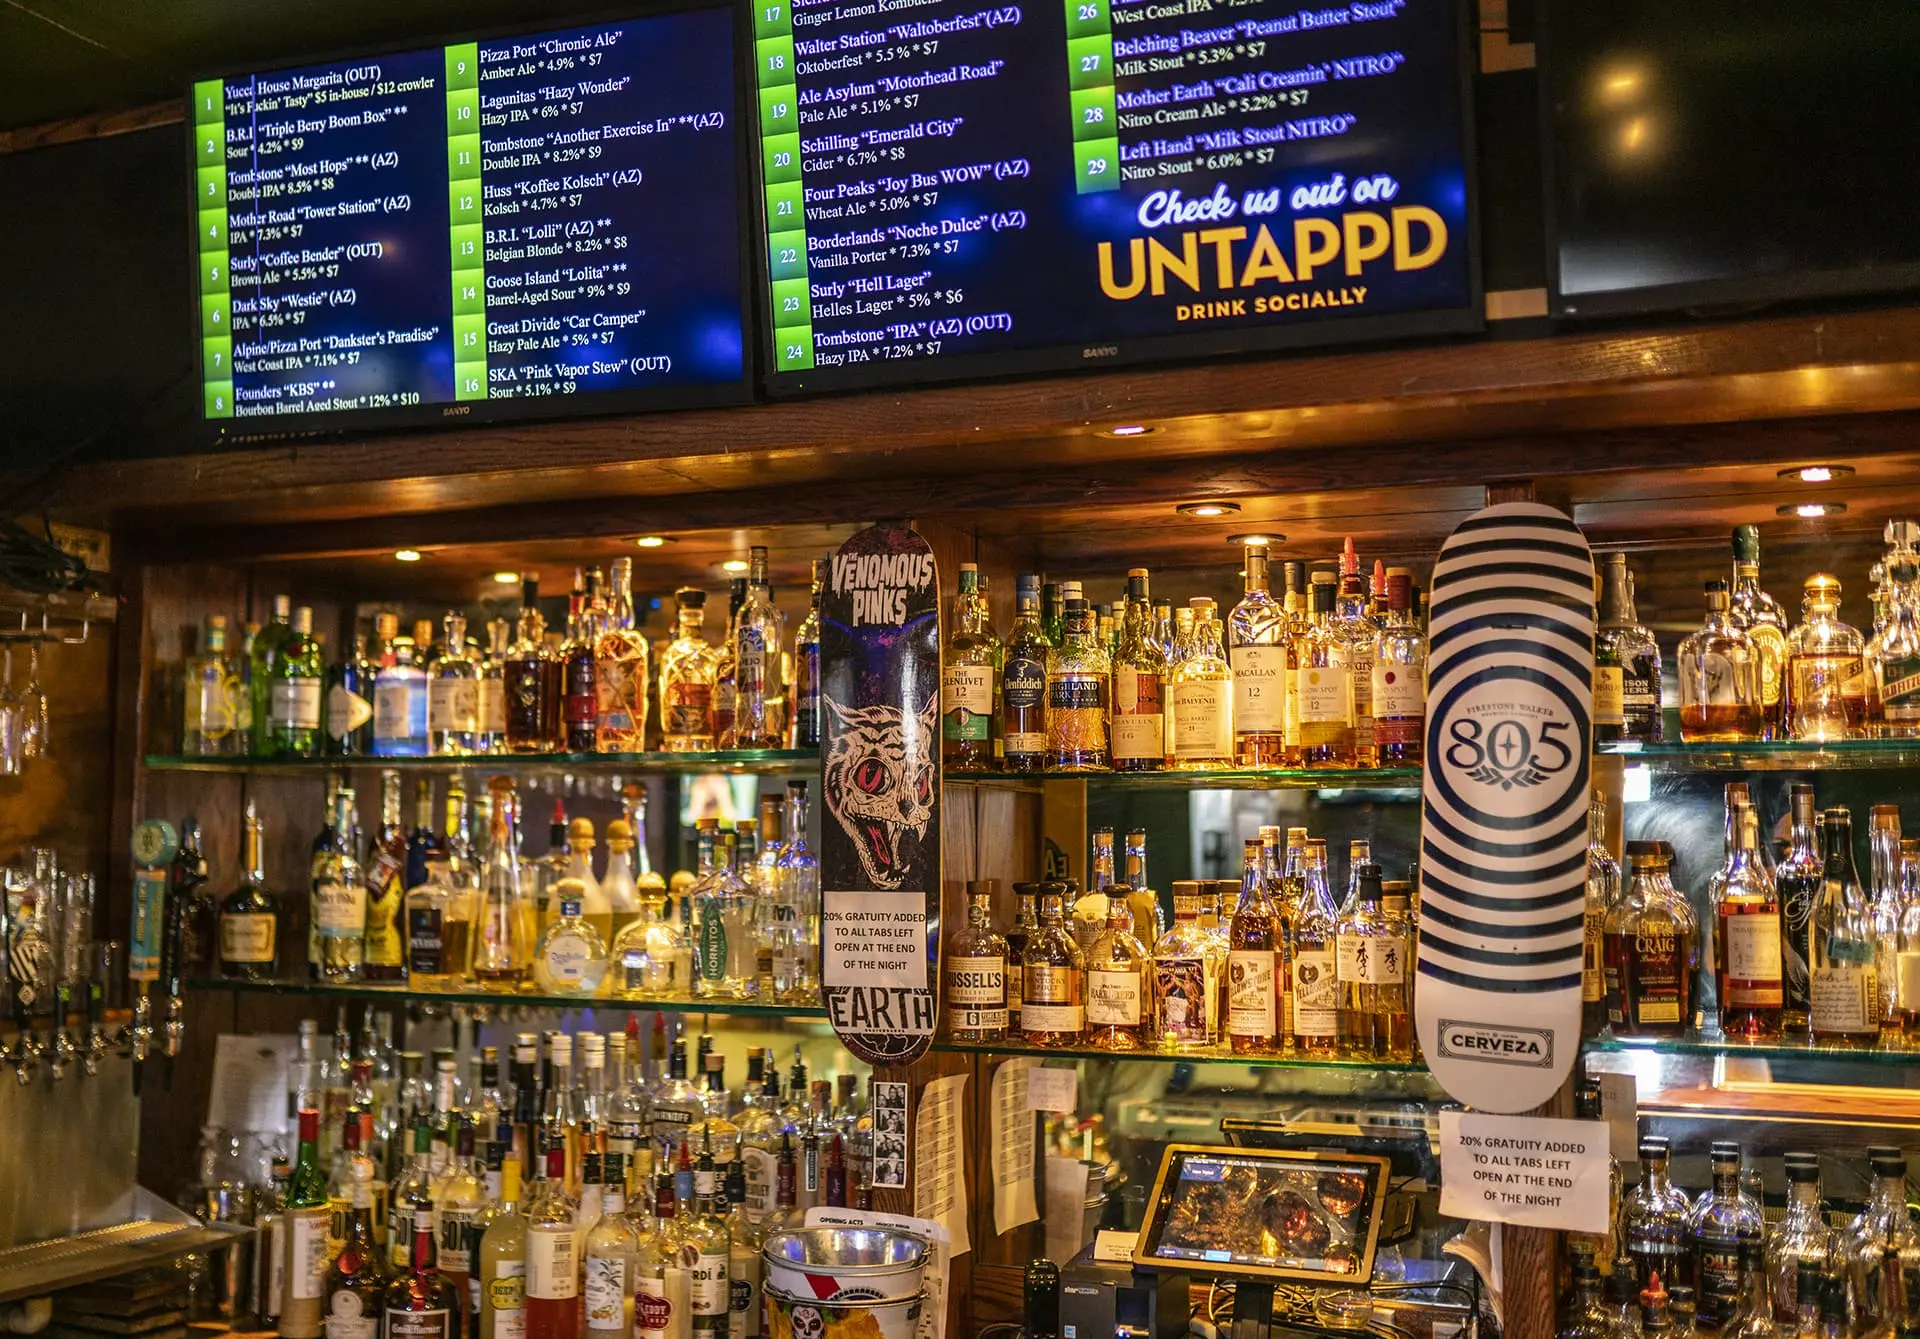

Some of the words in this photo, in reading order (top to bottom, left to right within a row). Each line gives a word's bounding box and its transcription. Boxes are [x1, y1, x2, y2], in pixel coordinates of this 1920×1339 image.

[765, 7, 780, 21] 17
[792, 11, 832, 26] Ginger
[835, 4, 876, 19] Lemon
[1113, 35, 1179, 56] Belching
[1182, 28, 1235, 46] Beaver
[1301, 10, 1349, 28] Butter
[479, 48, 510, 63] Pizza
[512, 44, 536, 58] Port
[458, 63, 465, 74] 9
[1082, 56, 1100, 71] 27
[481, 90, 536, 109] Lagunitas
[798, 89, 821, 105] Ale
[824, 83, 875, 101] Asylum
[457, 107, 470, 119] 10
[772, 104, 786, 118] 19
[801, 134, 858, 153] Schilling
[1120, 142, 1150, 160] Left
[1153, 136, 1193, 156] Hand
[1244, 127, 1284, 144] Stout
[774, 153, 790, 167] 20
[1088, 160, 1106, 174] 29
[1138, 182, 1236, 227] Check
[1243, 187, 1279, 215] us
[1292, 172, 1348, 208] out
[1354, 174, 1399, 200] on
[1098, 204, 1448, 301] UNTAPPD
[486, 275, 522, 288] Goose
[524, 269, 560, 285] Island
[232, 298, 257, 312] Dark
[259, 296, 279, 312] Sky
[329, 289, 356, 306] (AZ)
[462, 287, 475, 299] 14
[1177, 301, 1246, 321] DRINK
[1255, 287, 1367, 313] SOCIALLY
[213, 311, 219, 322] 6
[813, 330, 884, 346] Tombstone
[929, 318, 962, 338] (AZ)
[966, 313, 1011, 334] (OUT)
[233, 339, 297, 359] Alpine/Pizza
[299, 338, 321, 351] Port
[787, 345, 803, 358] 24
[215, 355, 221, 365] 7
[489, 367, 517, 381] SKA
[554, 363, 590, 379] Vapor
[630, 355, 671, 374] (OUT)
[465, 379, 478, 391] 16
[235, 403, 274, 416] Bourbon
[276, 400, 304, 414] Barrel
[306, 397, 331, 412] Aged
[332, 397, 358, 410] Stout
[369, 394, 390, 407] 12%
[400, 392, 419, 405] $10
[832, 553, 934, 598] VENOMOUS
[853, 582, 908, 628] PINKS
[1235, 669, 1276, 677] MACALLAN
[943, 678, 984, 687] GLENLIVET
[1005, 676, 1042, 689] Glenfiddich
[1051, 682, 1098, 690] HIGHLAND
[955, 687, 966, 696] 12
[1248, 687, 1261, 697] 12
[1311, 701, 1320, 710] 12
[1387, 701, 1396, 710] 15
[1467, 704, 1515, 714] FIRESTONE
[1520, 704, 1554, 716] WALKER
[1446, 719, 1572, 773] 805
[824, 913, 842, 921] 20%
[845, 913, 891, 921] GRATUITY
[893, 914, 925, 922] ADDED
[835, 928, 848, 936] TO
[851, 928, 866, 936] ALL
[869, 929, 892, 937] TABS
[895, 929, 914, 937] LEFT
[708, 918, 719, 977] HORNITOS
[835, 943, 859, 951] OPEN
[862, 944, 874, 952] AT
[876, 944, 894, 952] THE
[896, 944, 915, 953] END
[1636, 937, 1675, 954] CRAIG
[859, 961, 876, 969] THE
[878, 961, 907, 970] NIGHT
[831, 987, 933, 1029] EARTH
[970, 1014, 976, 1024] 6
[1452, 1034, 1540, 1055] CERVEZA
[1460, 1136, 1482, 1147] 20%
[1485, 1138, 1541, 1151] GRATUITY
[1546, 1143, 1585, 1153] ADDED
[1474, 1154, 1488, 1164] TO
[1491, 1156, 1511, 1166] ALL
[1514, 1157, 1542, 1168] TABS
[1546, 1160, 1570, 1170] LEFT
[1473, 1171, 1502, 1182] OPEN
[1506, 1173, 1522, 1183] AT
[1525, 1175, 1545, 1186] THE
[1548, 1177, 1572, 1188] END
[1484, 1190, 1498, 1200] OF
[1501, 1192, 1522, 1203] THE
[1525, 1195, 1561, 1207] NIGHT
[820, 1217, 847, 1225] OPENING
